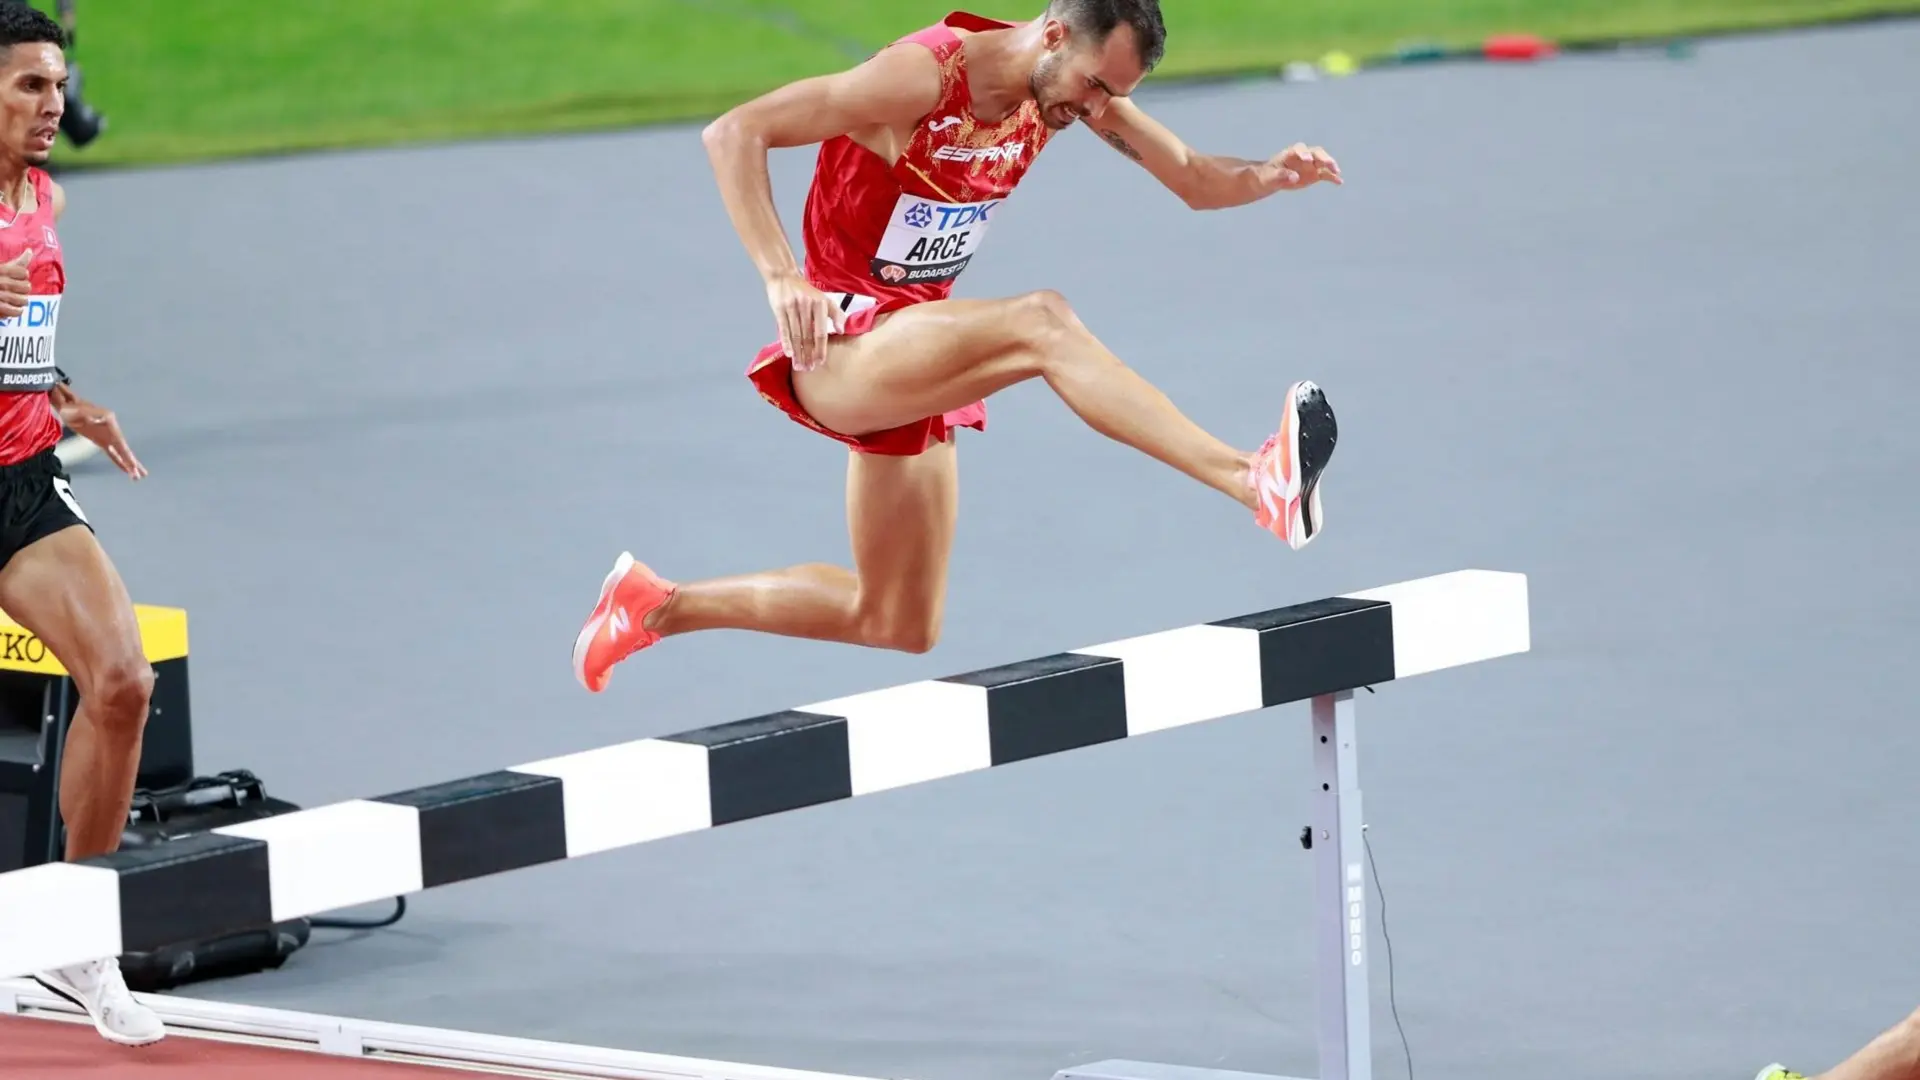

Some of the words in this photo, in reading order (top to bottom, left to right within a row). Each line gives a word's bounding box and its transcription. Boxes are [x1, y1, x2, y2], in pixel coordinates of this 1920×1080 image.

[932, 141, 1025, 163] ESPAÑA
[935, 201, 1001, 231] TDK
[904, 231, 970, 262] ARCE
